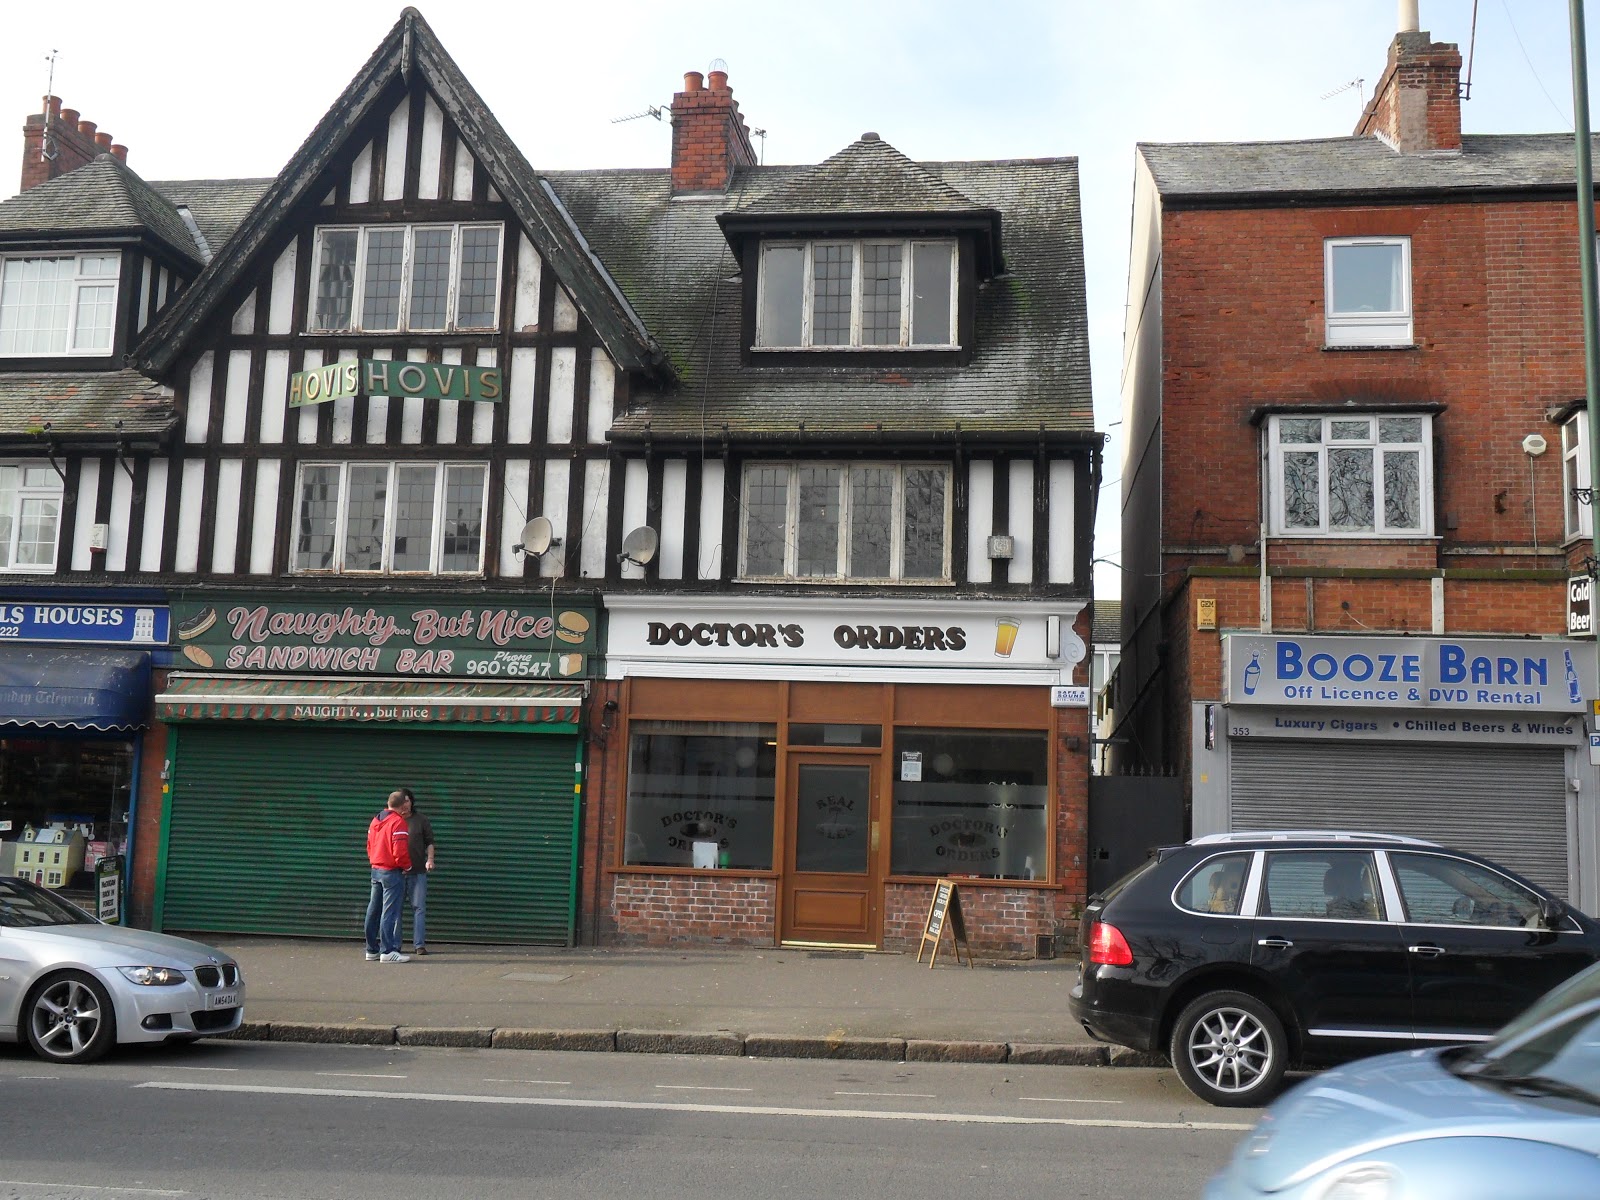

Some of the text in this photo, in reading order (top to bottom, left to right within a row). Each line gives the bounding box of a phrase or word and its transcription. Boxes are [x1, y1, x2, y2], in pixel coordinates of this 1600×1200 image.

[291, 364, 358, 403] HOVIS
[367, 362, 500, 398] HOVIS
[1571, 583, 1589, 602] Cold
[1200, 600, 1214, 608] GEM
[33, 606, 123, 626] HOUSES
[1570, 612, 1590, 630] Beer
[0, 626, 19, 637] 222
[476, 609, 554, 646] Nice
[647, 622, 966, 651] DOCTOR'S ORDERS
[225, 645, 455, 674] SANDWICH BAR
[493, 651, 532, 662] Phone
[1275, 641, 1421, 683] BOOZE
[1438, 643, 1548, 686] BARN
[1284, 685, 1541, 704] Off Licence & DVD Rental
[401, 706, 429, 718] nice
[1232, 727, 1250, 736] 353
[1275, 718, 1378, 732] Luxury Cigars
[1405, 720, 1574, 735] Chilled Beers & Wines
[1592, 736, 1600, 746] P
[668, 836, 729, 853] ORS
